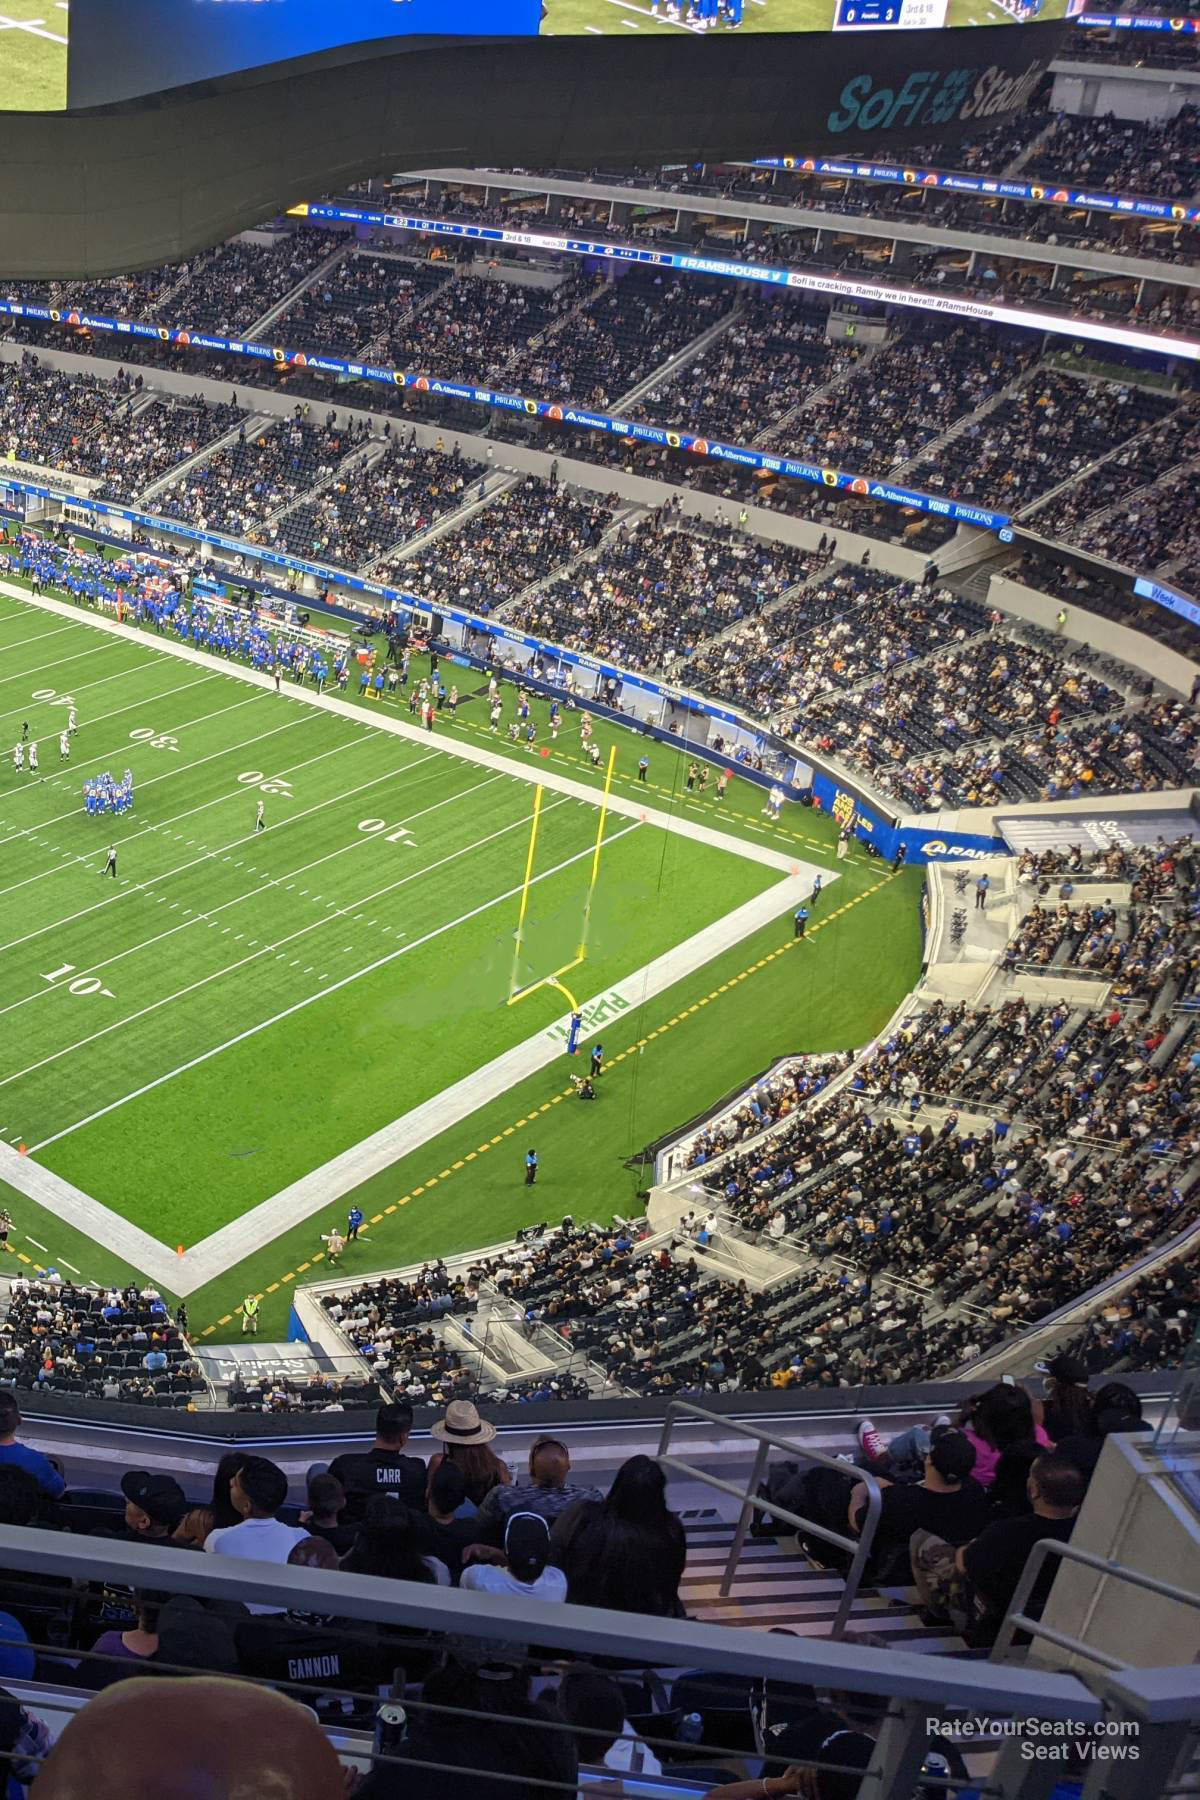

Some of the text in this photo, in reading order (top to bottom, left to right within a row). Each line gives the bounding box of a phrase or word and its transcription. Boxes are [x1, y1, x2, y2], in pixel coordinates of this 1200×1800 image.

[827, 72, 940, 133] SoFi
[680, 257, 770, 280] #RAMSHOUSE
[791, 275, 994, 317] Sofi is cracking. Ramily we in here!!! #RamsHouse
[722, 449, 819, 480] Albertsons VONS PAVILIONS
[885, 490, 993, 526] Albertsons VONS PAVILIONS
[363, 584, 383, 596] RAMS
[432, 606, 452, 617] RAMS
[504, 630, 525, 643] RAMS
[578, 657, 600, 670] RAMS
[31, 688, 79, 708] 40
[658, 687, 682, 701] RAMS
[128, 727, 180, 750] 30
[237, 771, 293, 795] 20
[835, 789, 856, 806] LOS
[357, 818, 416, 843] 10
[40, 962, 103, 996] 10
[376, 1468, 401, 1483] CARR
[288, 1654, 341, 1680] GANNON
